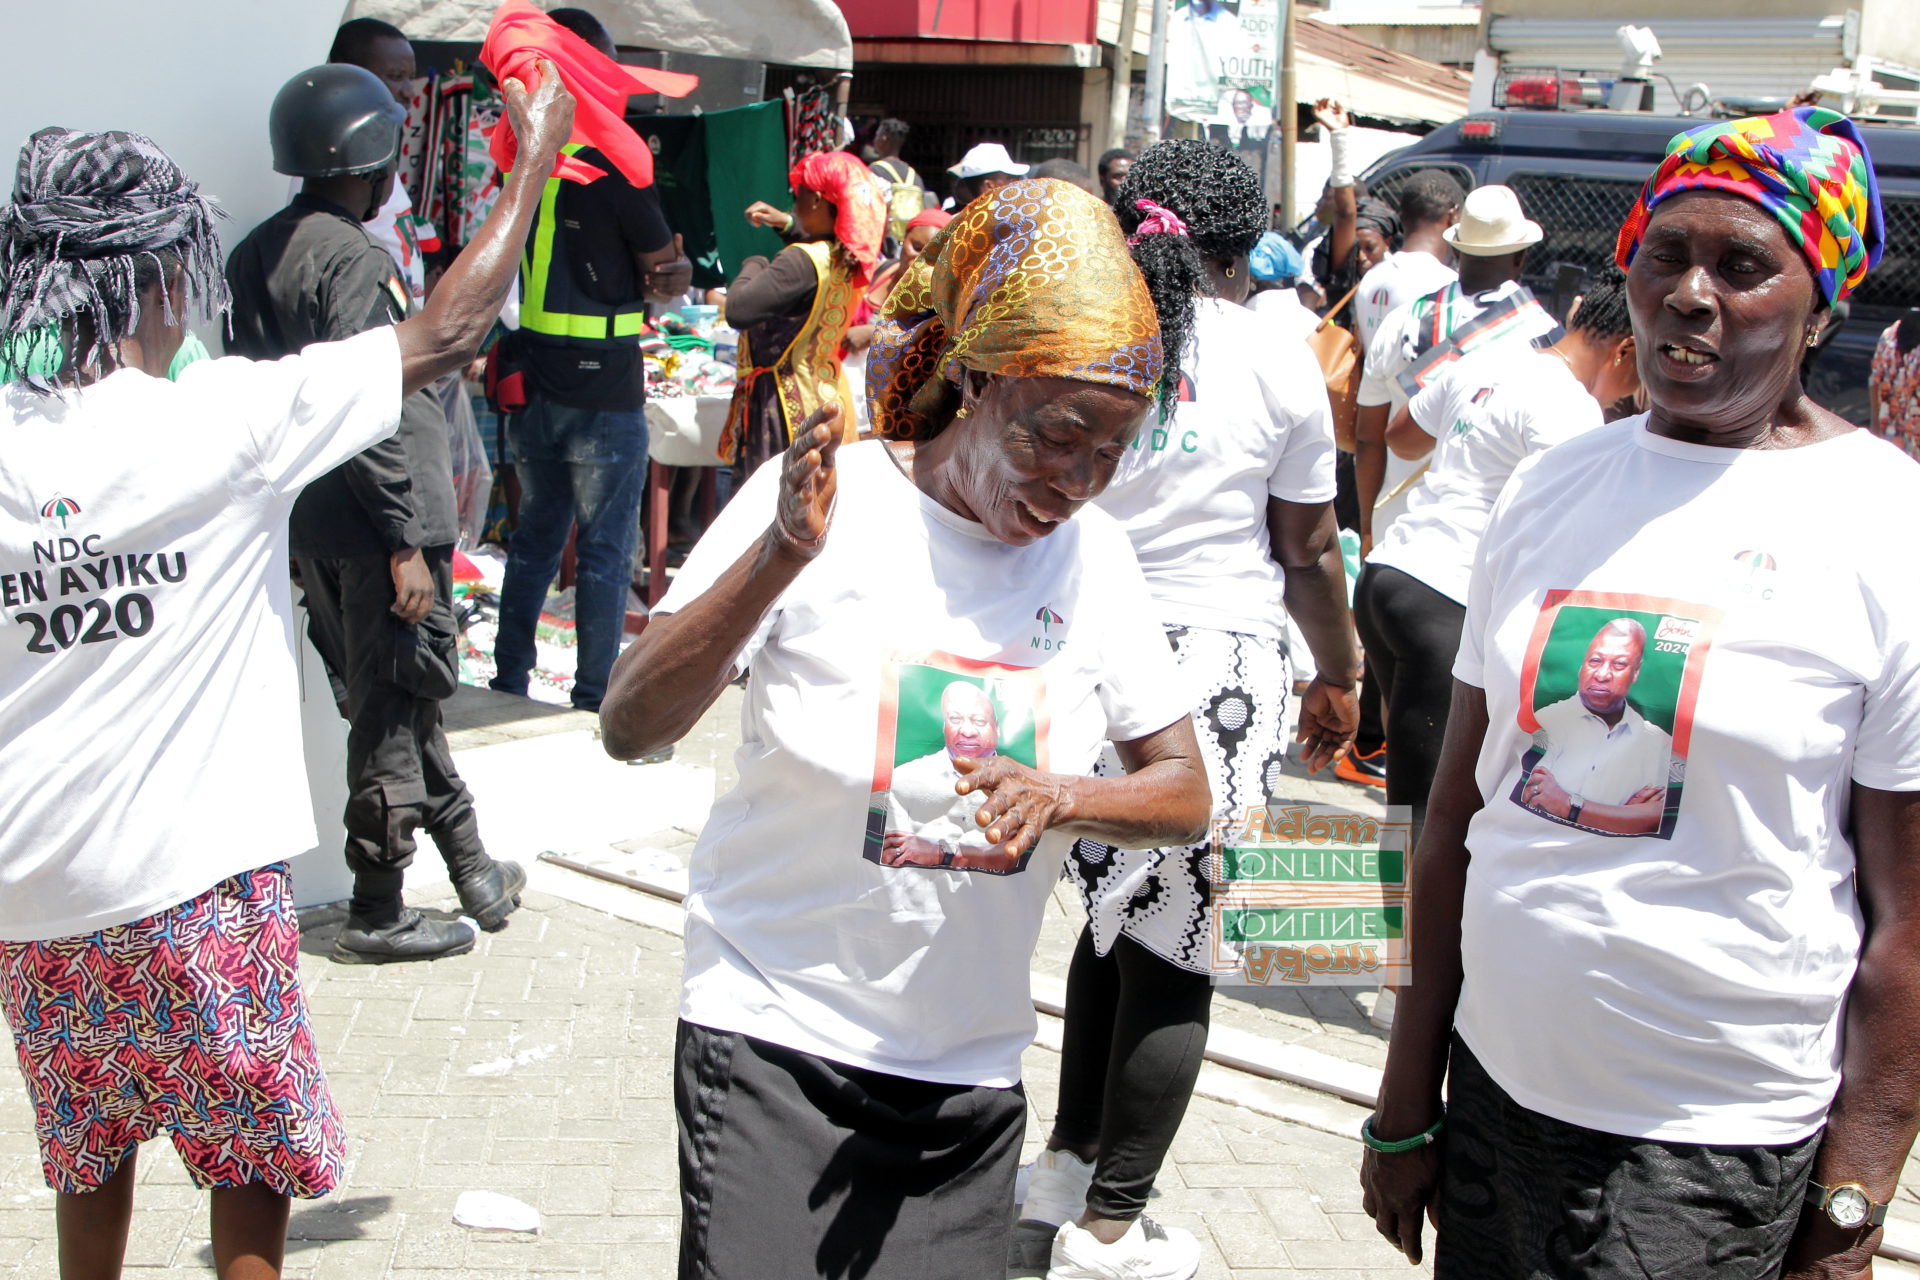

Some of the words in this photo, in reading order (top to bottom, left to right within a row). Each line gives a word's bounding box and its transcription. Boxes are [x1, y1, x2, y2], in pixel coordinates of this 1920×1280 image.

[1218, 56, 1274, 77] YOUTH
[33, 534, 105, 564] NDC
[1, 570, 48, 607] EN
[60, 551, 187, 596] AYIKU
[15, 593, 155, 653] 2020
[1030, 636, 1066, 651] NDC
